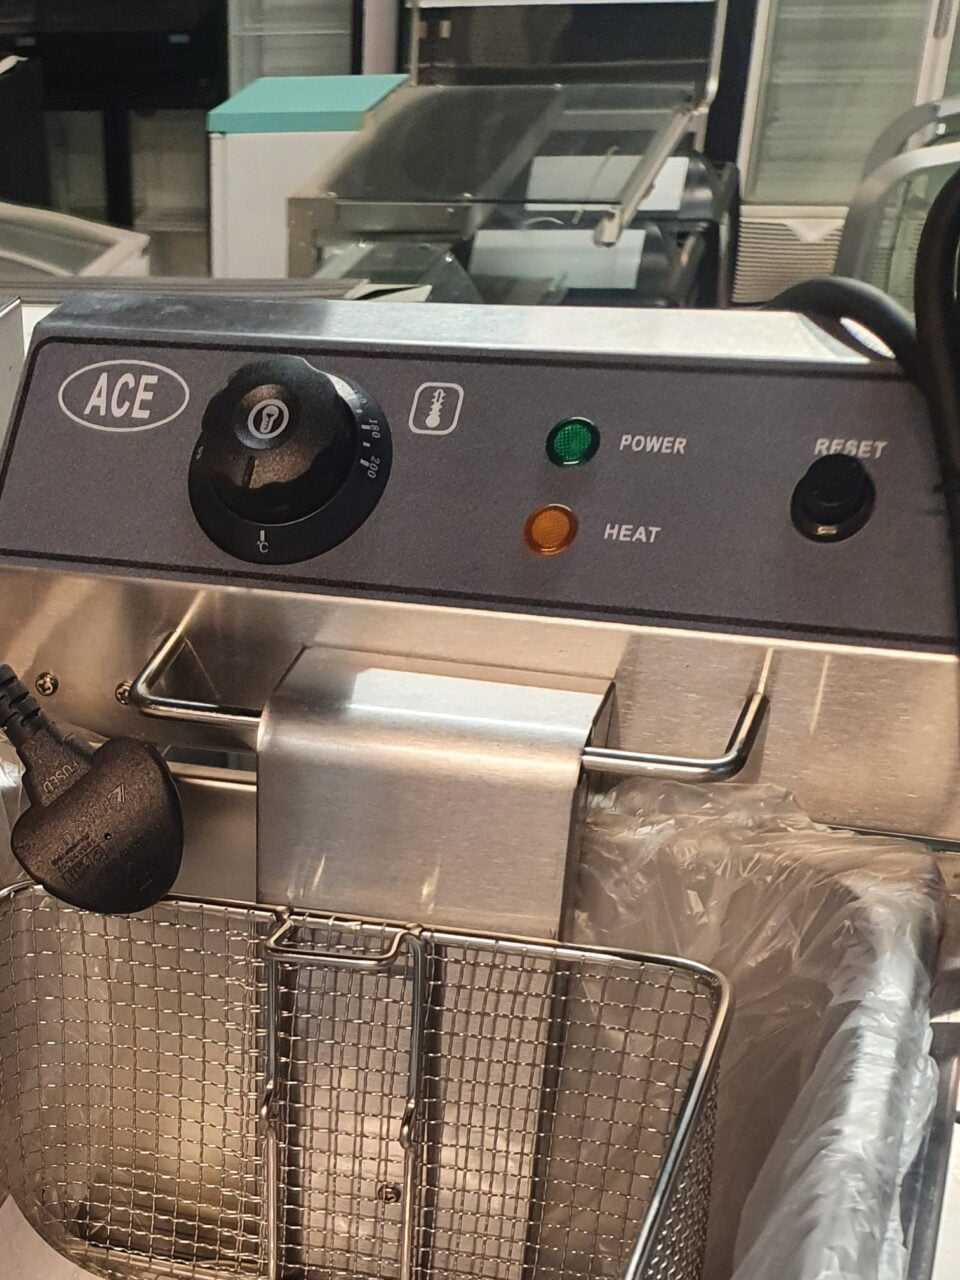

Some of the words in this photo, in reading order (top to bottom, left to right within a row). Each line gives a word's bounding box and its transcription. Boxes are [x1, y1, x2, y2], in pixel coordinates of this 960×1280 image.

[84, 372, 158, 419] ACE
[619, 434, 687, 455] POWER
[814, 438, 889, 459] RESET
[367, 455, 381, 479] 200
[604, 523, 662, 543] HEAT
[43, 761, 80, 794] FUSED
